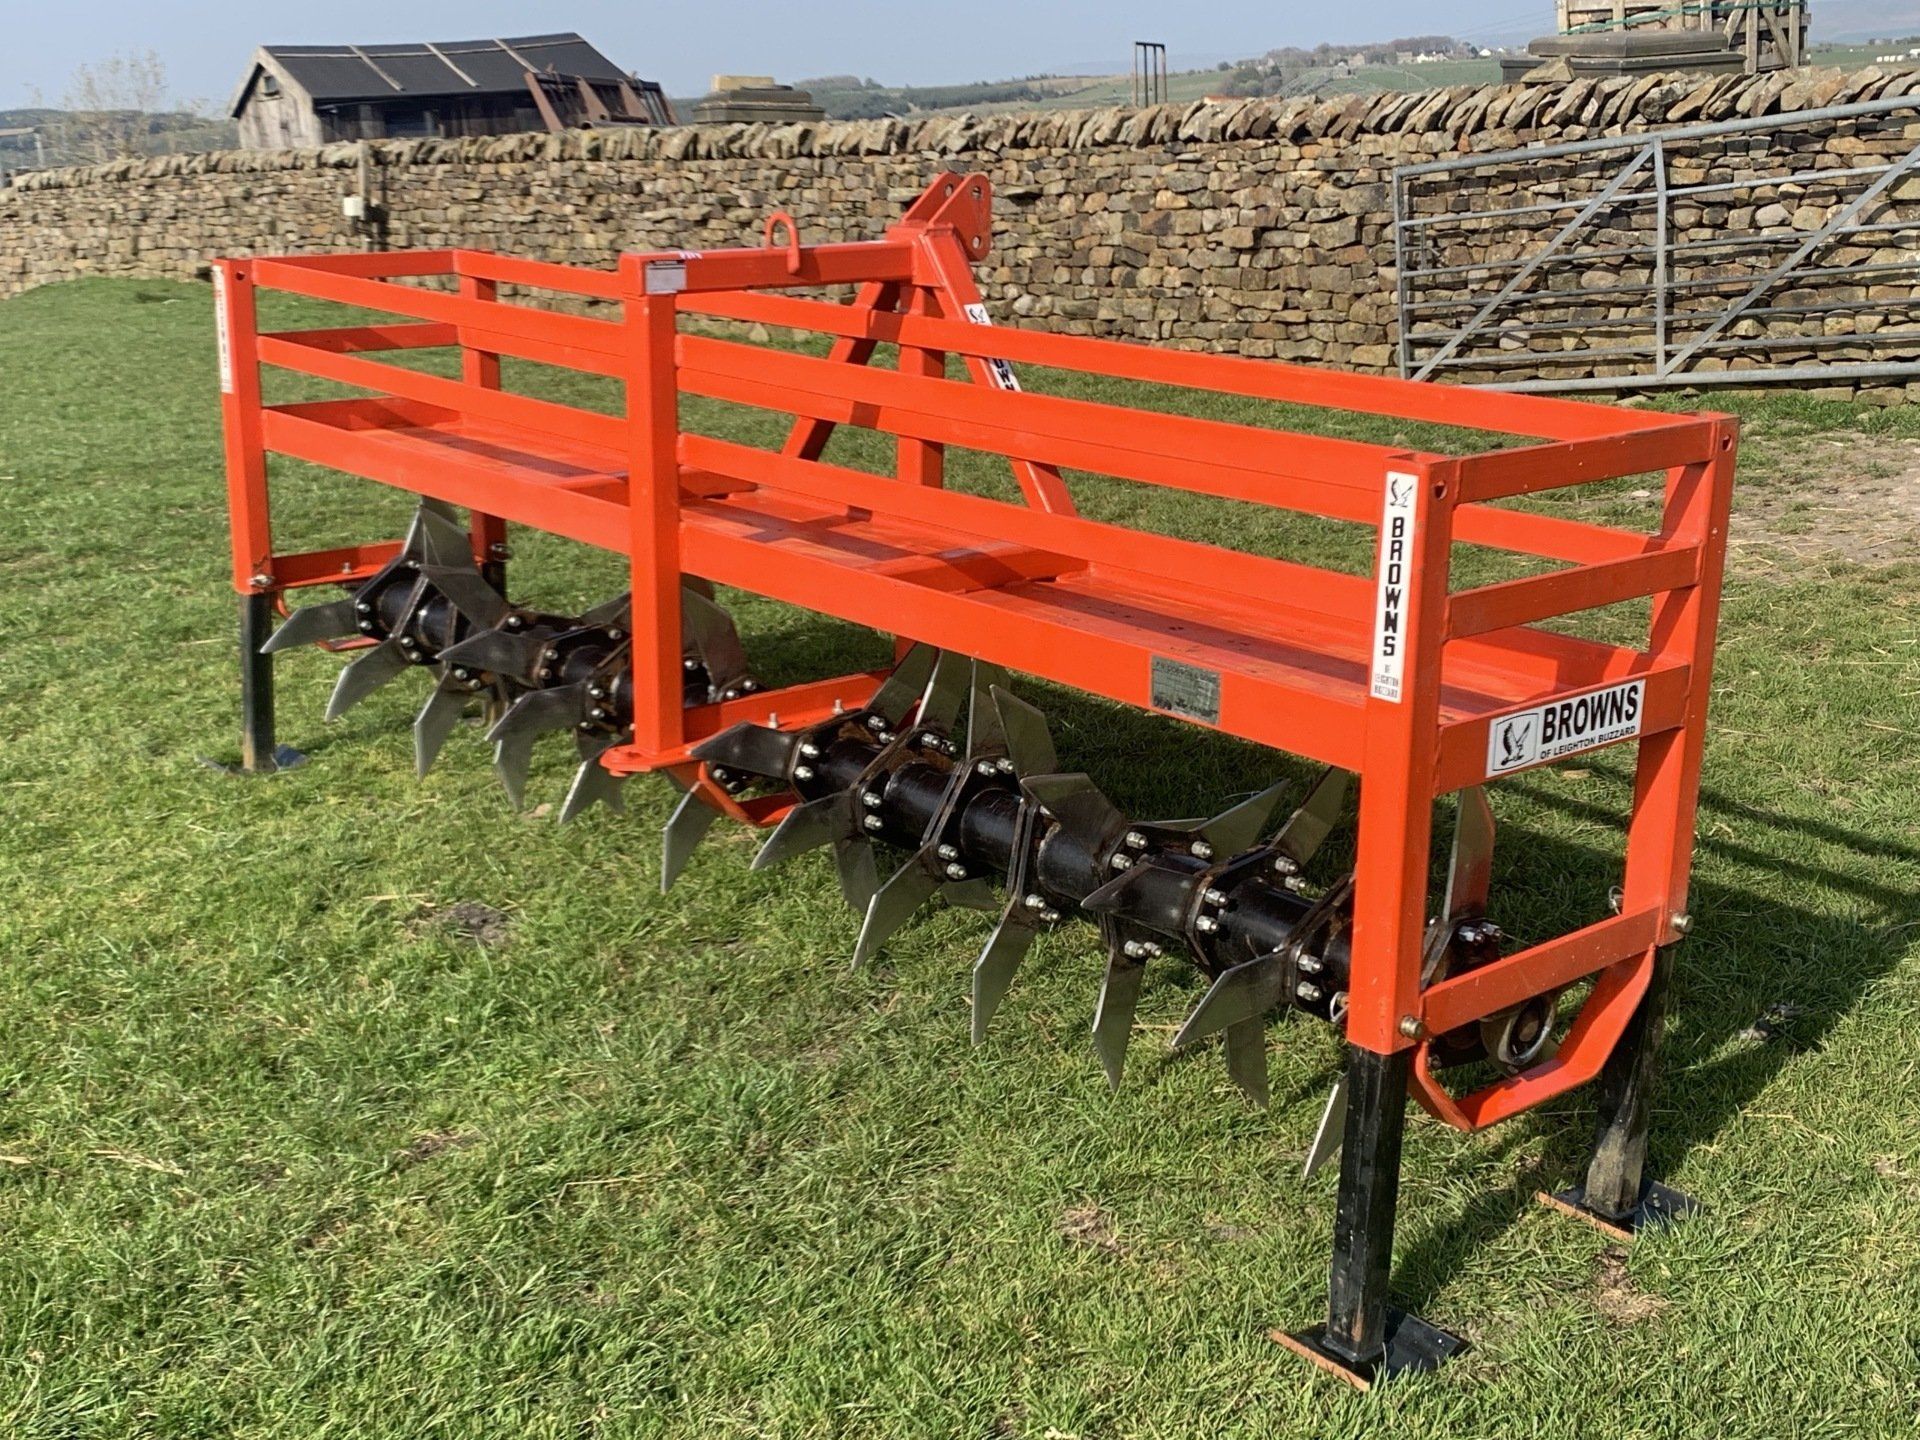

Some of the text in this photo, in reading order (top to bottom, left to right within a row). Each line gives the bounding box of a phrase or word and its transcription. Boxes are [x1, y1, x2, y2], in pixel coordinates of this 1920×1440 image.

[1383, 517, 1404, 656] BROWNS
[1540, 725, 1636, 760] OF LEIGHTON BUZZARD
[1541, 684, 1639, 744] BROWNS
